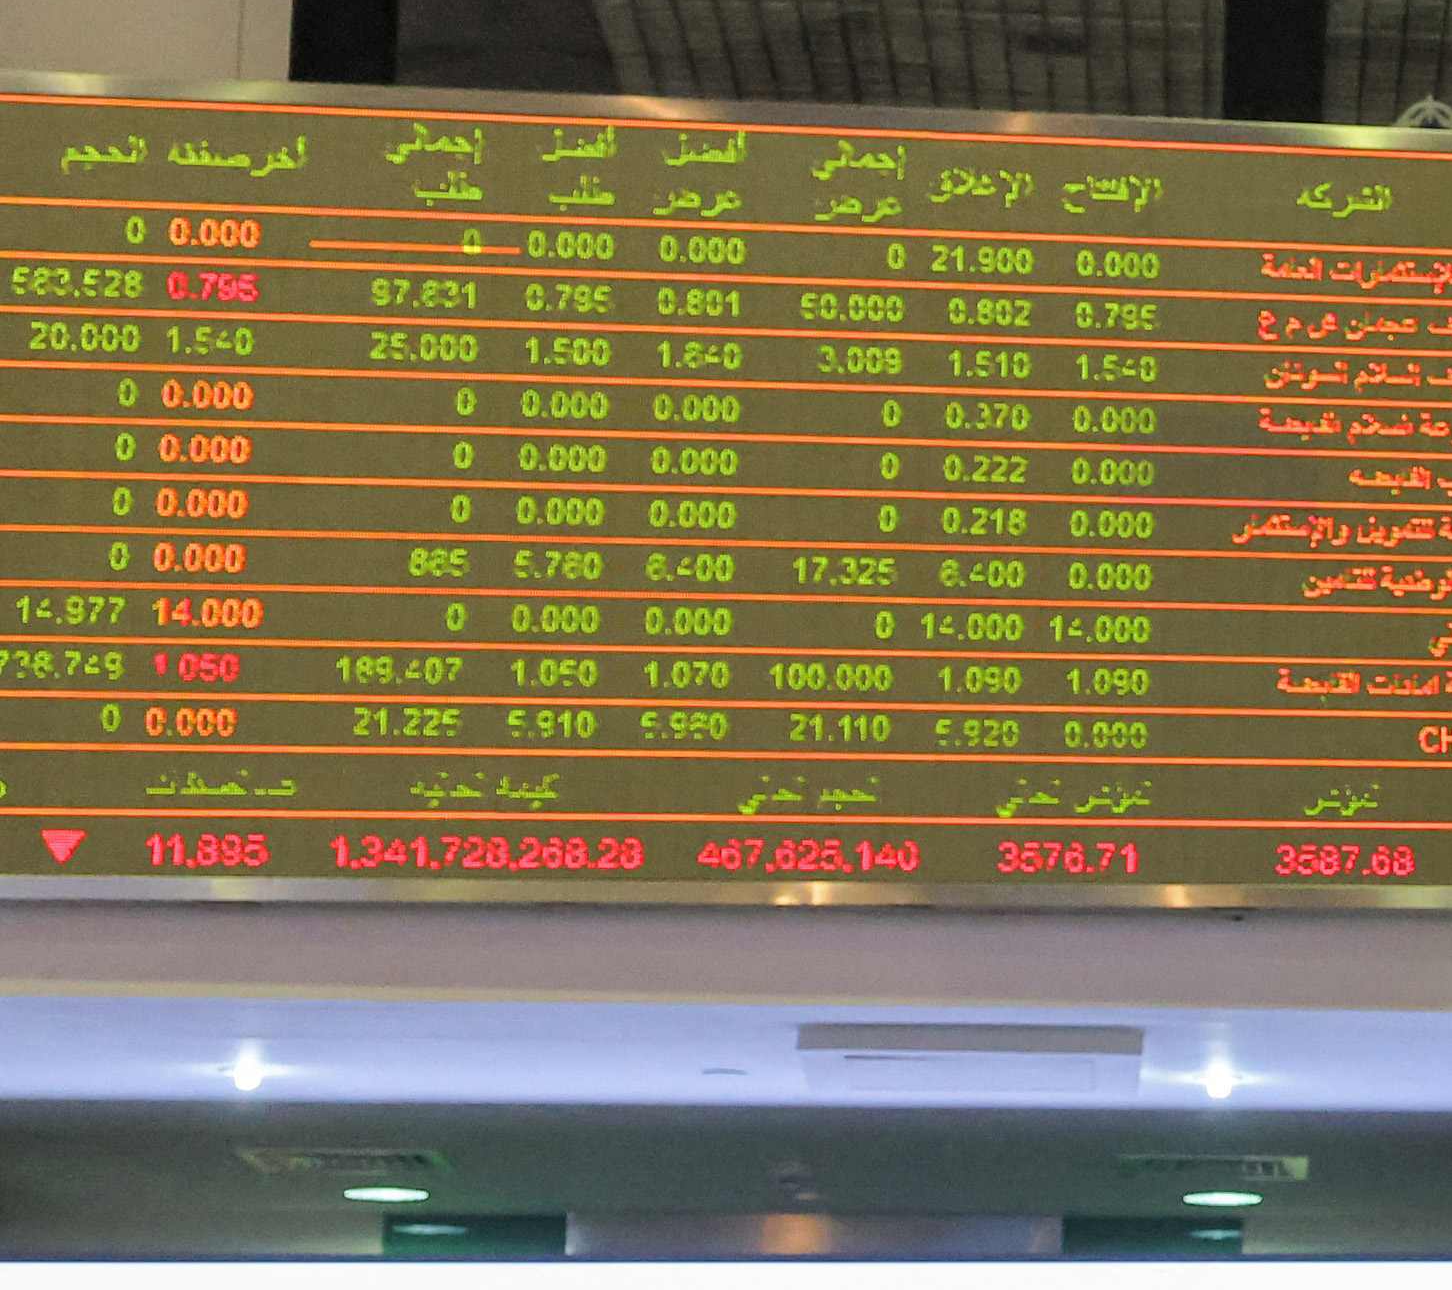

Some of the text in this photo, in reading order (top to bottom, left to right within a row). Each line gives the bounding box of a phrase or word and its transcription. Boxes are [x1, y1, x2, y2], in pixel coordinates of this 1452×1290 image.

[124, 215, 148, 244] 0
[170, 217, 262, 248] 0.000
[527, 229, 616, 262] 0.000
[658, 235, 747, 265] 0.000
[886, 241, 907, 270] 0
[930, 243, 1036, 275] 21.900
[1076, 249, 1161, 278] 0.000
[947, 297, 1034, 327] 0.802
[117, 378, 1157, 434] 0 0.000 0 0.000 0.000 0 0.370 0.000
[114, 432, 1154, 485] 0 0.000 0 0.000 0.000 0 0.222 0.000
[112, 487, 1156, 538] 0 0.000 0 0.000 0.000 0 0.218 0.000
[108, 541, 1153, 591] 0 0.000 0.000
[445, 602, 469, 631] 0
[512, 604, 601, 634] 0.000
[645, 606, 734, 636] 0.000
[875, 611, 896, 639] 0
[100, 703, 122, 732] 0
[1064, 720, 1149, 749] 0.000
